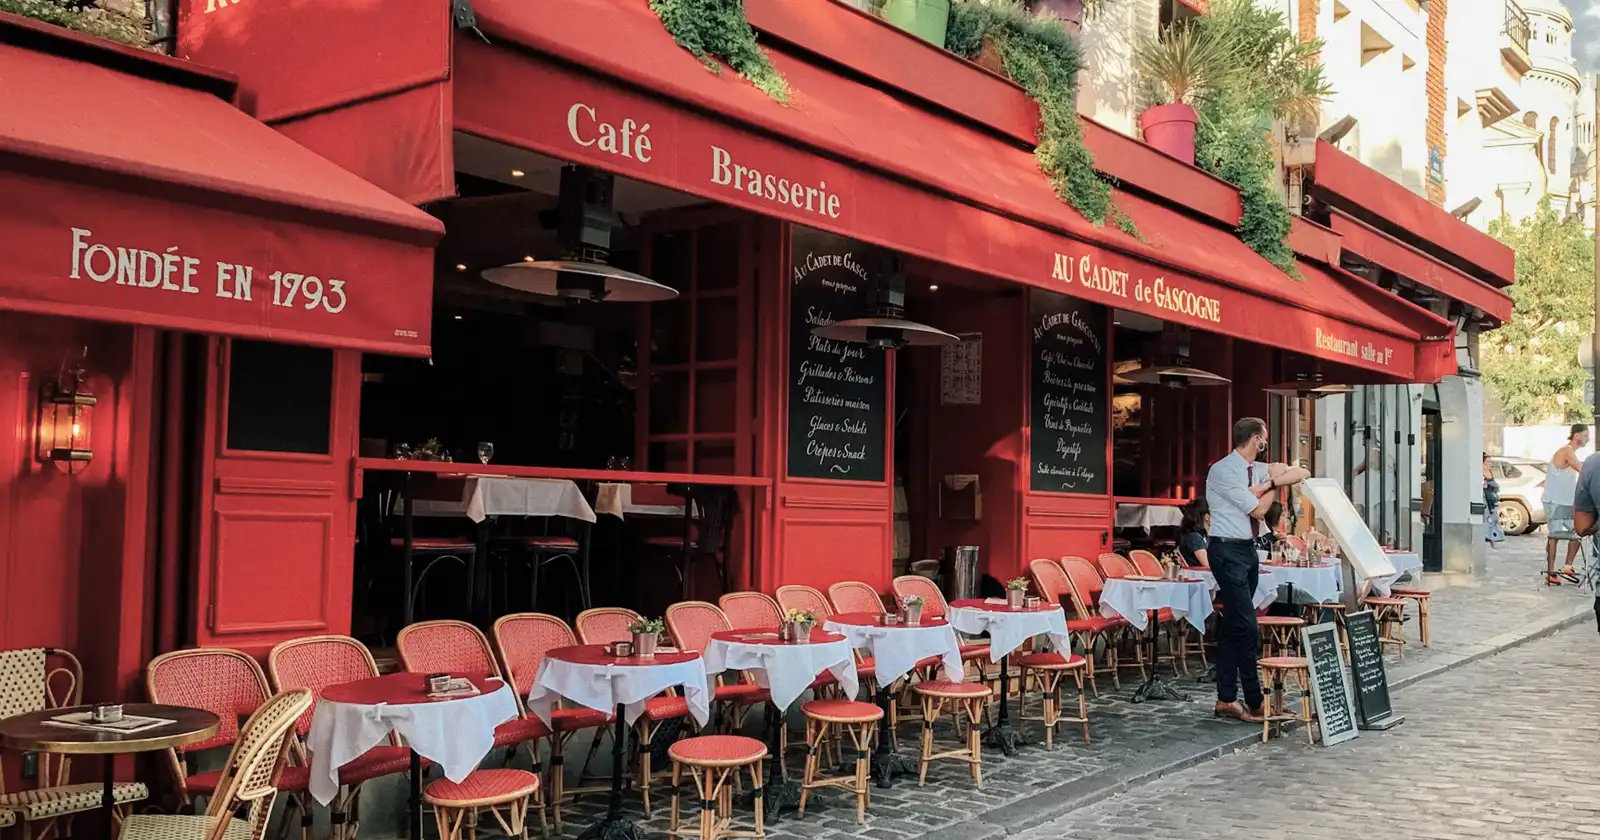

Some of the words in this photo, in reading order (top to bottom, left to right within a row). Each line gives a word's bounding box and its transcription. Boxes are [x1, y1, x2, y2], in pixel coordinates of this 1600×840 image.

[567, 103, 652, 163] Café
[710, 144, 841, 219] Brasserie
[69, 227, 200, 293] FONDÉE
[216, 261, 253, 301] EN
[268, 270, 347, 314] 1793
[1052, 252, 1074, 283] AU
[1079, 254, 1129, 298] CADET
[1135, 278, 1152, 303] de
[1154, 276, 1221, 323] GASCOGNE
[807, 335, 831, 353] Plats
[1315, 327, 1358, 358] Restaurant
[1361, 342, 1376, 362] salle
[798, 360, 836, 385] Grillades
[843, 366, 873, 385] Poissons
[845, 397, 870, 411] maison
[807, 415, 834, 437] Glaces
[841, 418, 867, 434] Sorbets
[806, 439, 837, 465] Crêpes
[842, 443, 866, 460] Snack
[1056, 437, 1081, 461] Digestifs
